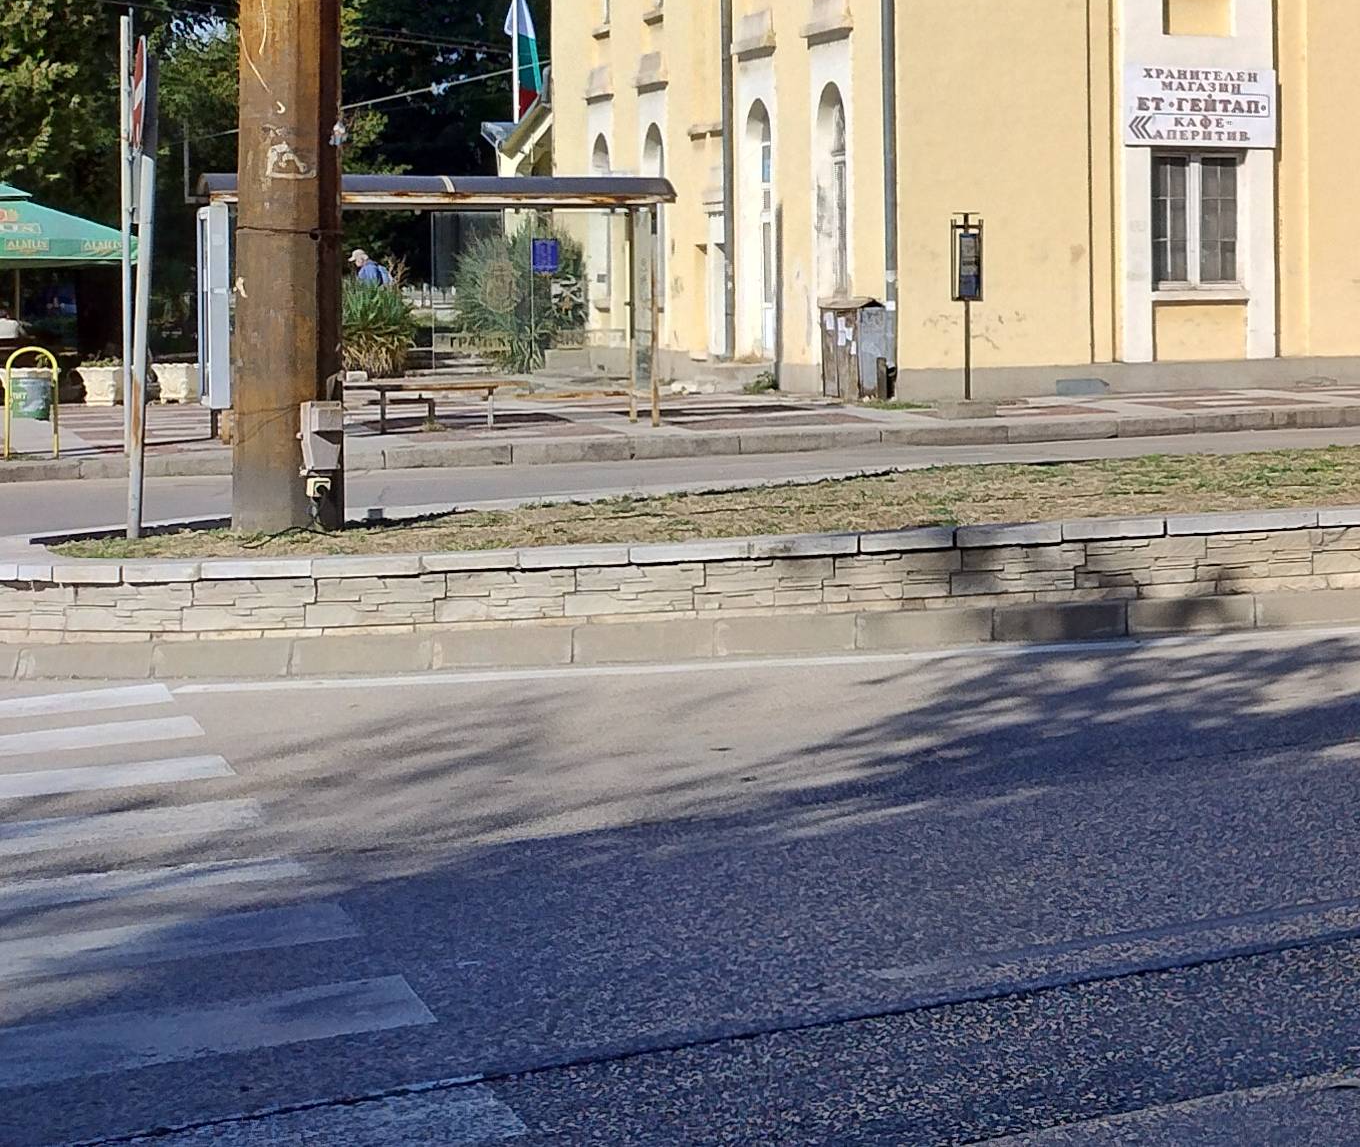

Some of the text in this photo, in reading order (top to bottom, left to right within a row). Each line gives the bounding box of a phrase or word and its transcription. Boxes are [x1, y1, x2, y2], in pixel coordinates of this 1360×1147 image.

[1142, 67, 1258, 83] ХРАНИТЕЛЕН
[1161, 81, 1242, 94] МАГАЗИН
[1136, 96, 1165, 112] ЕТ
[1152, 129, 1250, 142] АПЕРИТИВ
[7, 238, 49, 249] ALMUS
